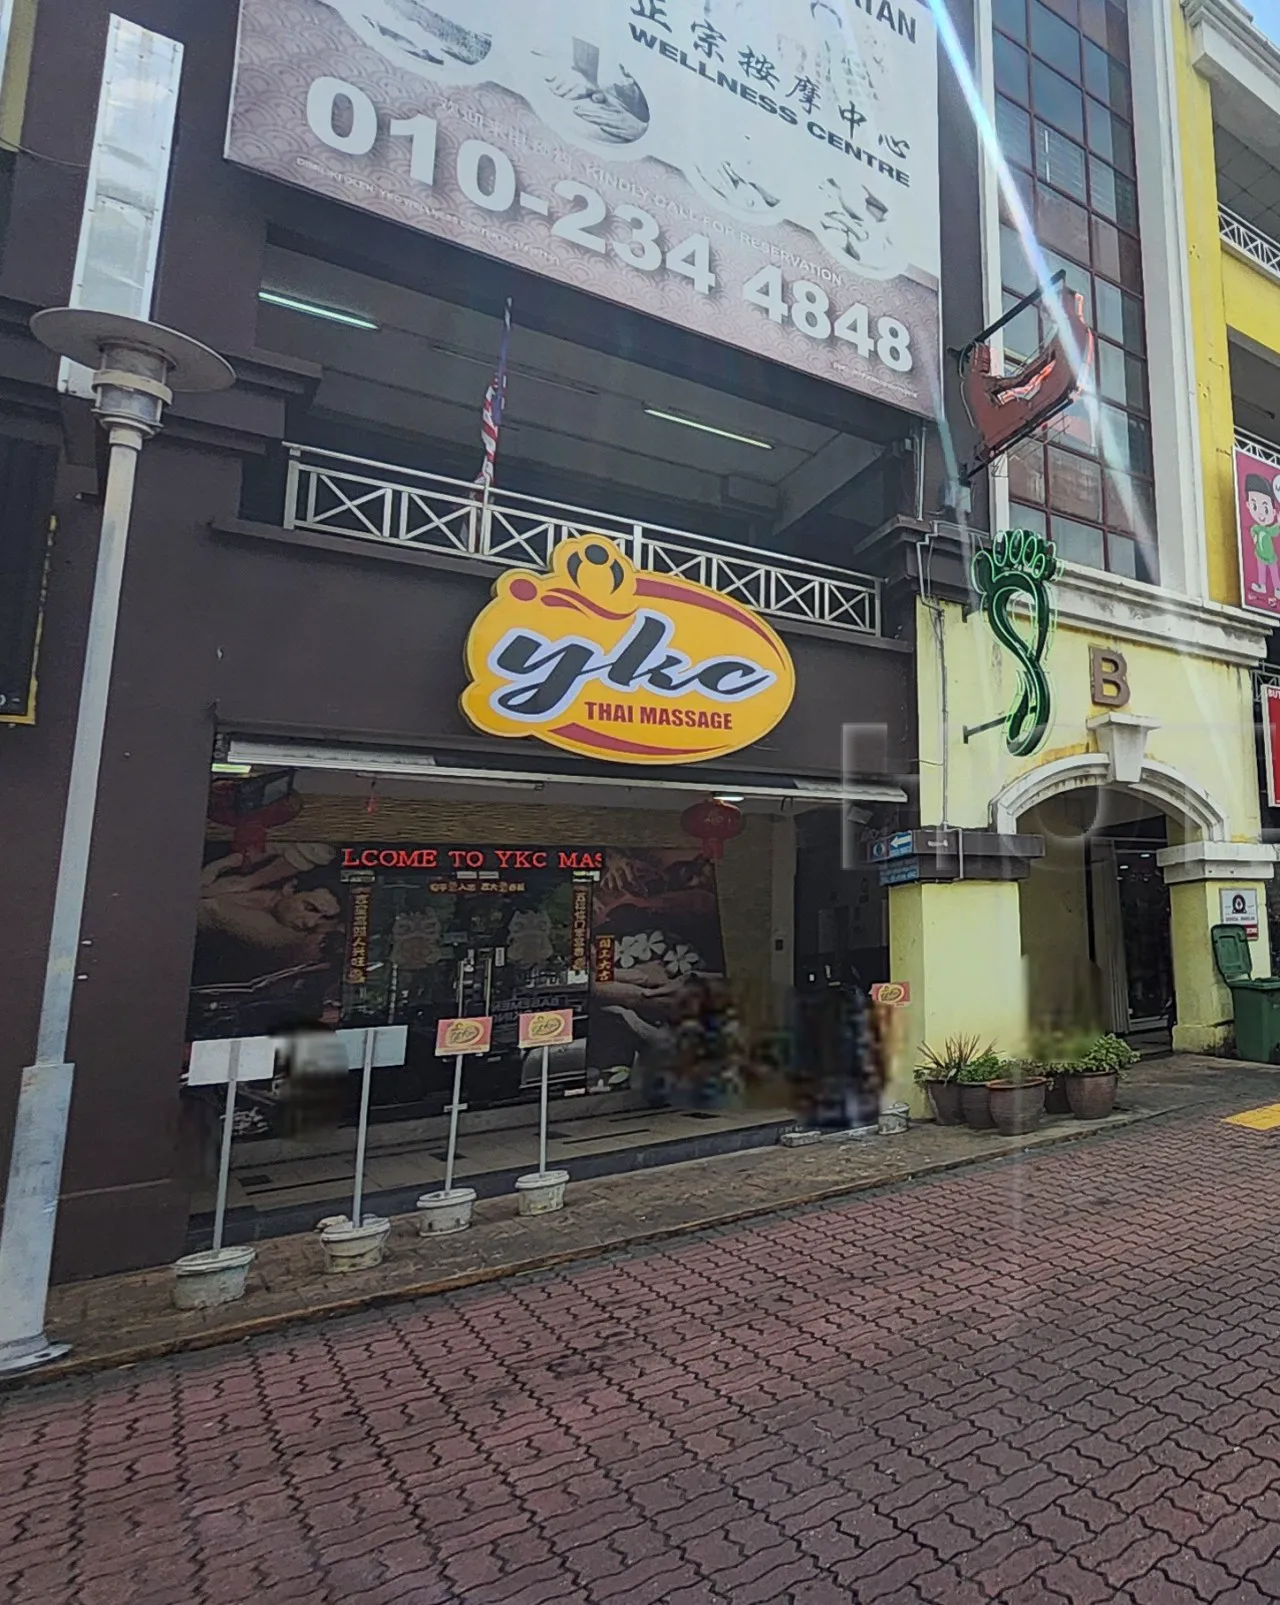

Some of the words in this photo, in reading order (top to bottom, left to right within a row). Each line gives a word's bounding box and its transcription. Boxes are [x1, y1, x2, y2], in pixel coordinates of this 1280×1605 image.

[852, 0, 916, 44] IAN
[628, 22, 799, 126] WELLNESS
[806, 120, 911, 188] CENTRE
[629, 0, 911, 160] 正宗按摩中心
[306, 75, 716, 295] 010-234
[743, 264, 913, 373] 4848
[586, 164, 650, 199] KINDLY
[656, 194, 698, 222] CALL
[703, 215, 735, 238] FOR
[740, 227, 842, 285] RESERVATION
[584, 701, 634, 724] THAI
[640, 704, 733, 731] MASSAGE
[1088, 643, 1131, 708] B
[341, 848, 438, 869] LCOME
[448, 850, 485, 868] TO
[494, 850, 548, 869] YKC
